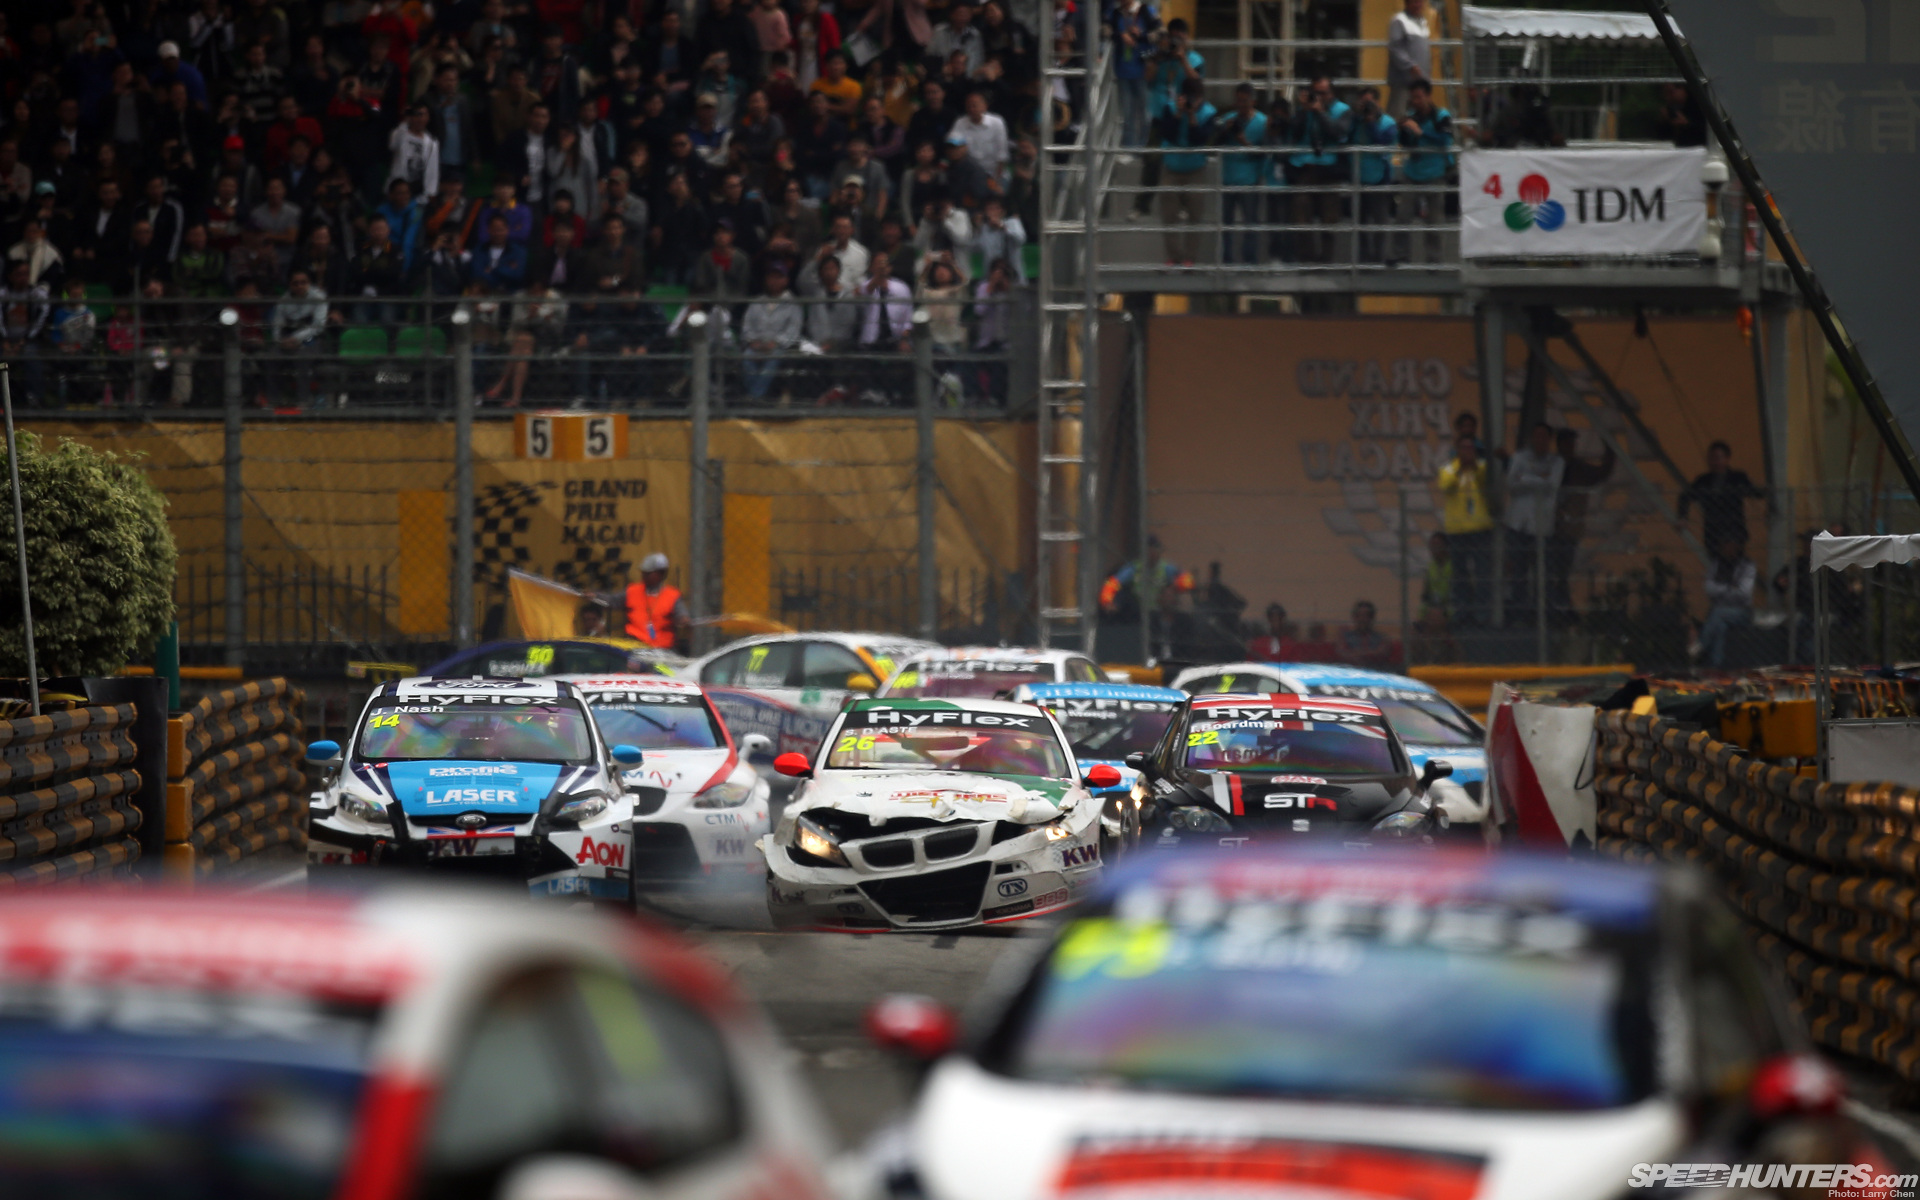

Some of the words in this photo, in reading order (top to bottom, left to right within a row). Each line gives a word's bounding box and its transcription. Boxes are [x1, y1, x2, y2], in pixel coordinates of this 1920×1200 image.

[1482, 173, 1503, 199] 4
[1573, 186, 1666, 224] TDM
[532, 418, 547, 457] 5
[588, 418, 608, 456] 5
[563, 480, 648, 498] GRAND
[563, 502, 617, 521] PRIX
[561, 523, 645, 545] MACAU
[436, 679, 518, 689] Ford
[399, 694, 558, 705] HyFlex
[371, 706, 387, 716] J.
[394, 705, 444, 713] Nash
[1207, 708, 1365, 722] HyFlex
[369, 715, 401, 728] 14
[868, 711, 1030, 727] HyFlex
[844, 728, 858, 736] S.
[1187, 731, 1218, 746] 22
[837, 736, 875, 752] 26
[427, 789, 517, 804] LASER
[1264, 792, 1337, 811] STR
[716, 839, 746, 854] KW
[1062, 843, 1098, 867] KW
[1033, 888, 1069, 909] BBS
